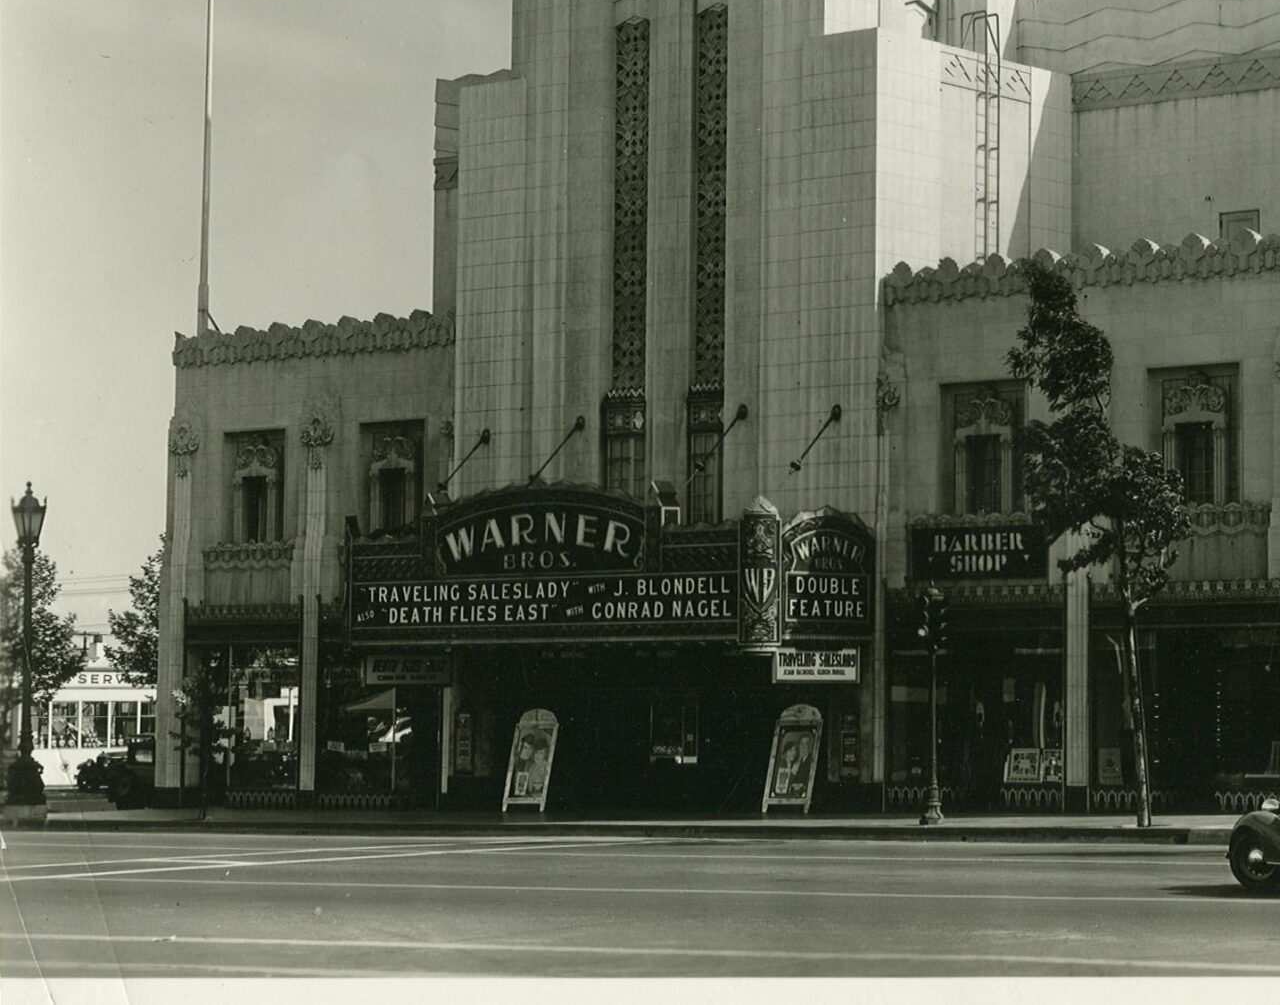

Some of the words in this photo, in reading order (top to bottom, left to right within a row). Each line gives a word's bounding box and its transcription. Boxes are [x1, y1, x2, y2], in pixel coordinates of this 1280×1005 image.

[446, 512, 631, 563] WARNER
[934, 533, 1024, 552] BARBER
[503, 550, 577, 570] BROS.
[950, 554, 1007, 572] SHOP
[587, 583, 606, 594] WITH
[614, 580, 629, 596] J.
[637, 576, 730, 596] BLONDELL
[796, 576, 860, 595] DOUBLE
[357, 610, 375, 622] ALSO
[450, 605, 497, 622] FLIES
[566, 605, 584, 617] WITH
[592, 600, 664, 619] CONRAD
[672, 599, 732, 618] NAGEL
[789, 599, 864, 617] FEATURE
